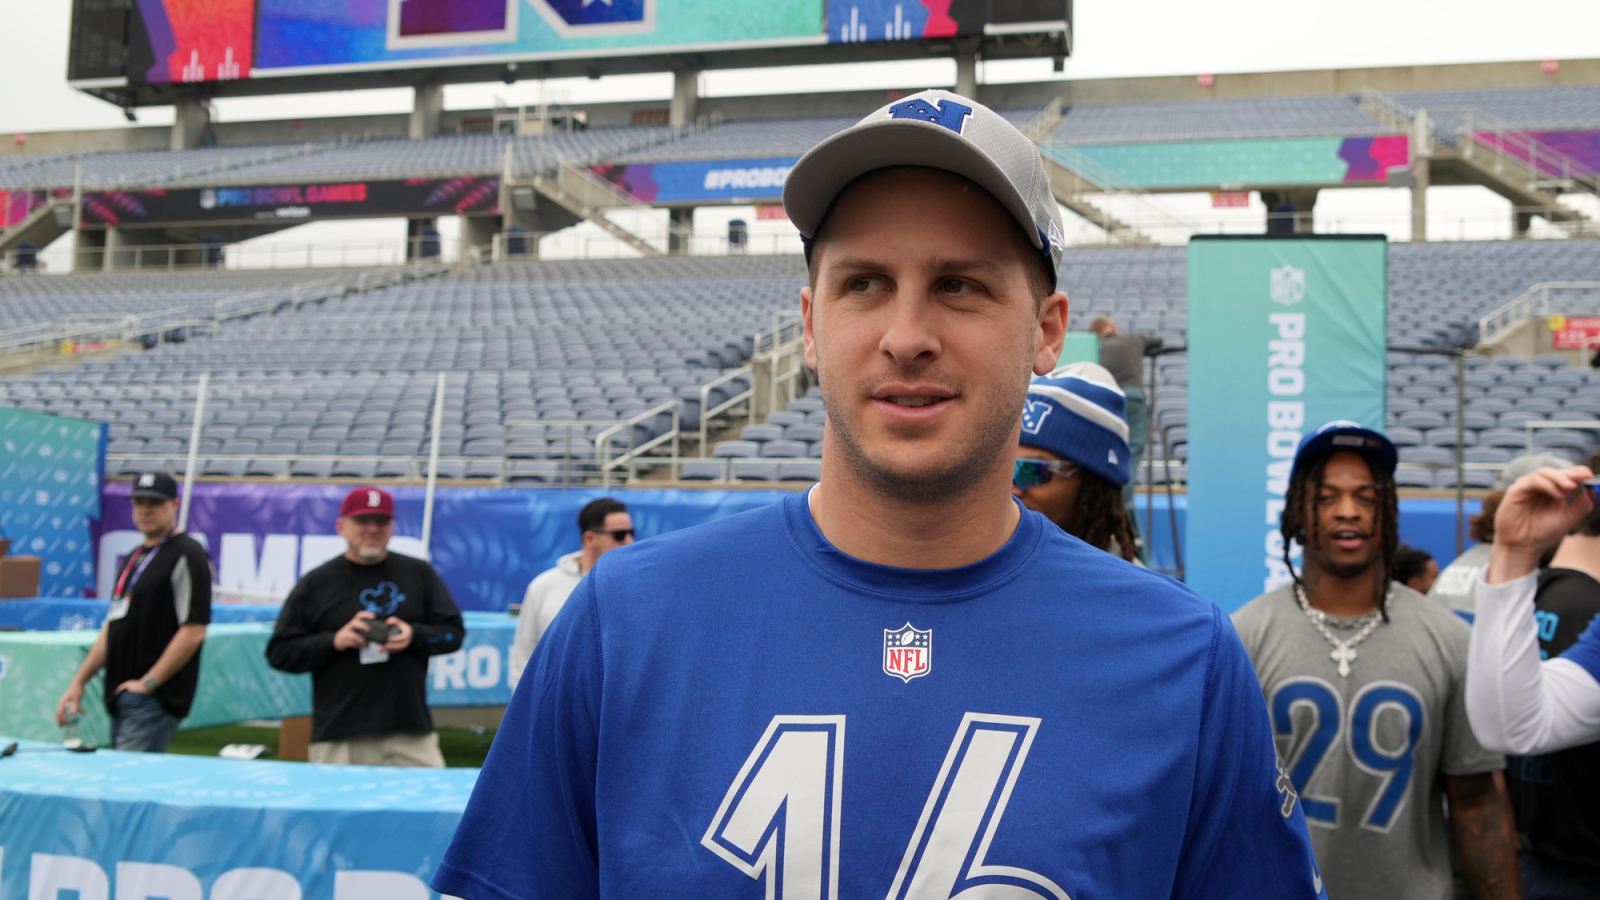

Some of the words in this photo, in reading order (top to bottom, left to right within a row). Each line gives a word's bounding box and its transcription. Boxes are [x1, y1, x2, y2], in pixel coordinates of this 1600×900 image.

[217, 188, 252, 208] PRO
[253, 186, 305, 206] BOWL
[306, 183, 369, 203] GAMES
[703, 166, 795, 191] #PROBO
[1267, 312, 1306, 396] PRO
[367, 490, 381, 508] B
[1264, 529, 1305, 594] GA
[429, 645, 501, 690] RO
[889, 649, 925, 674] NFL
[1269, 676, 1427, 835] 29
